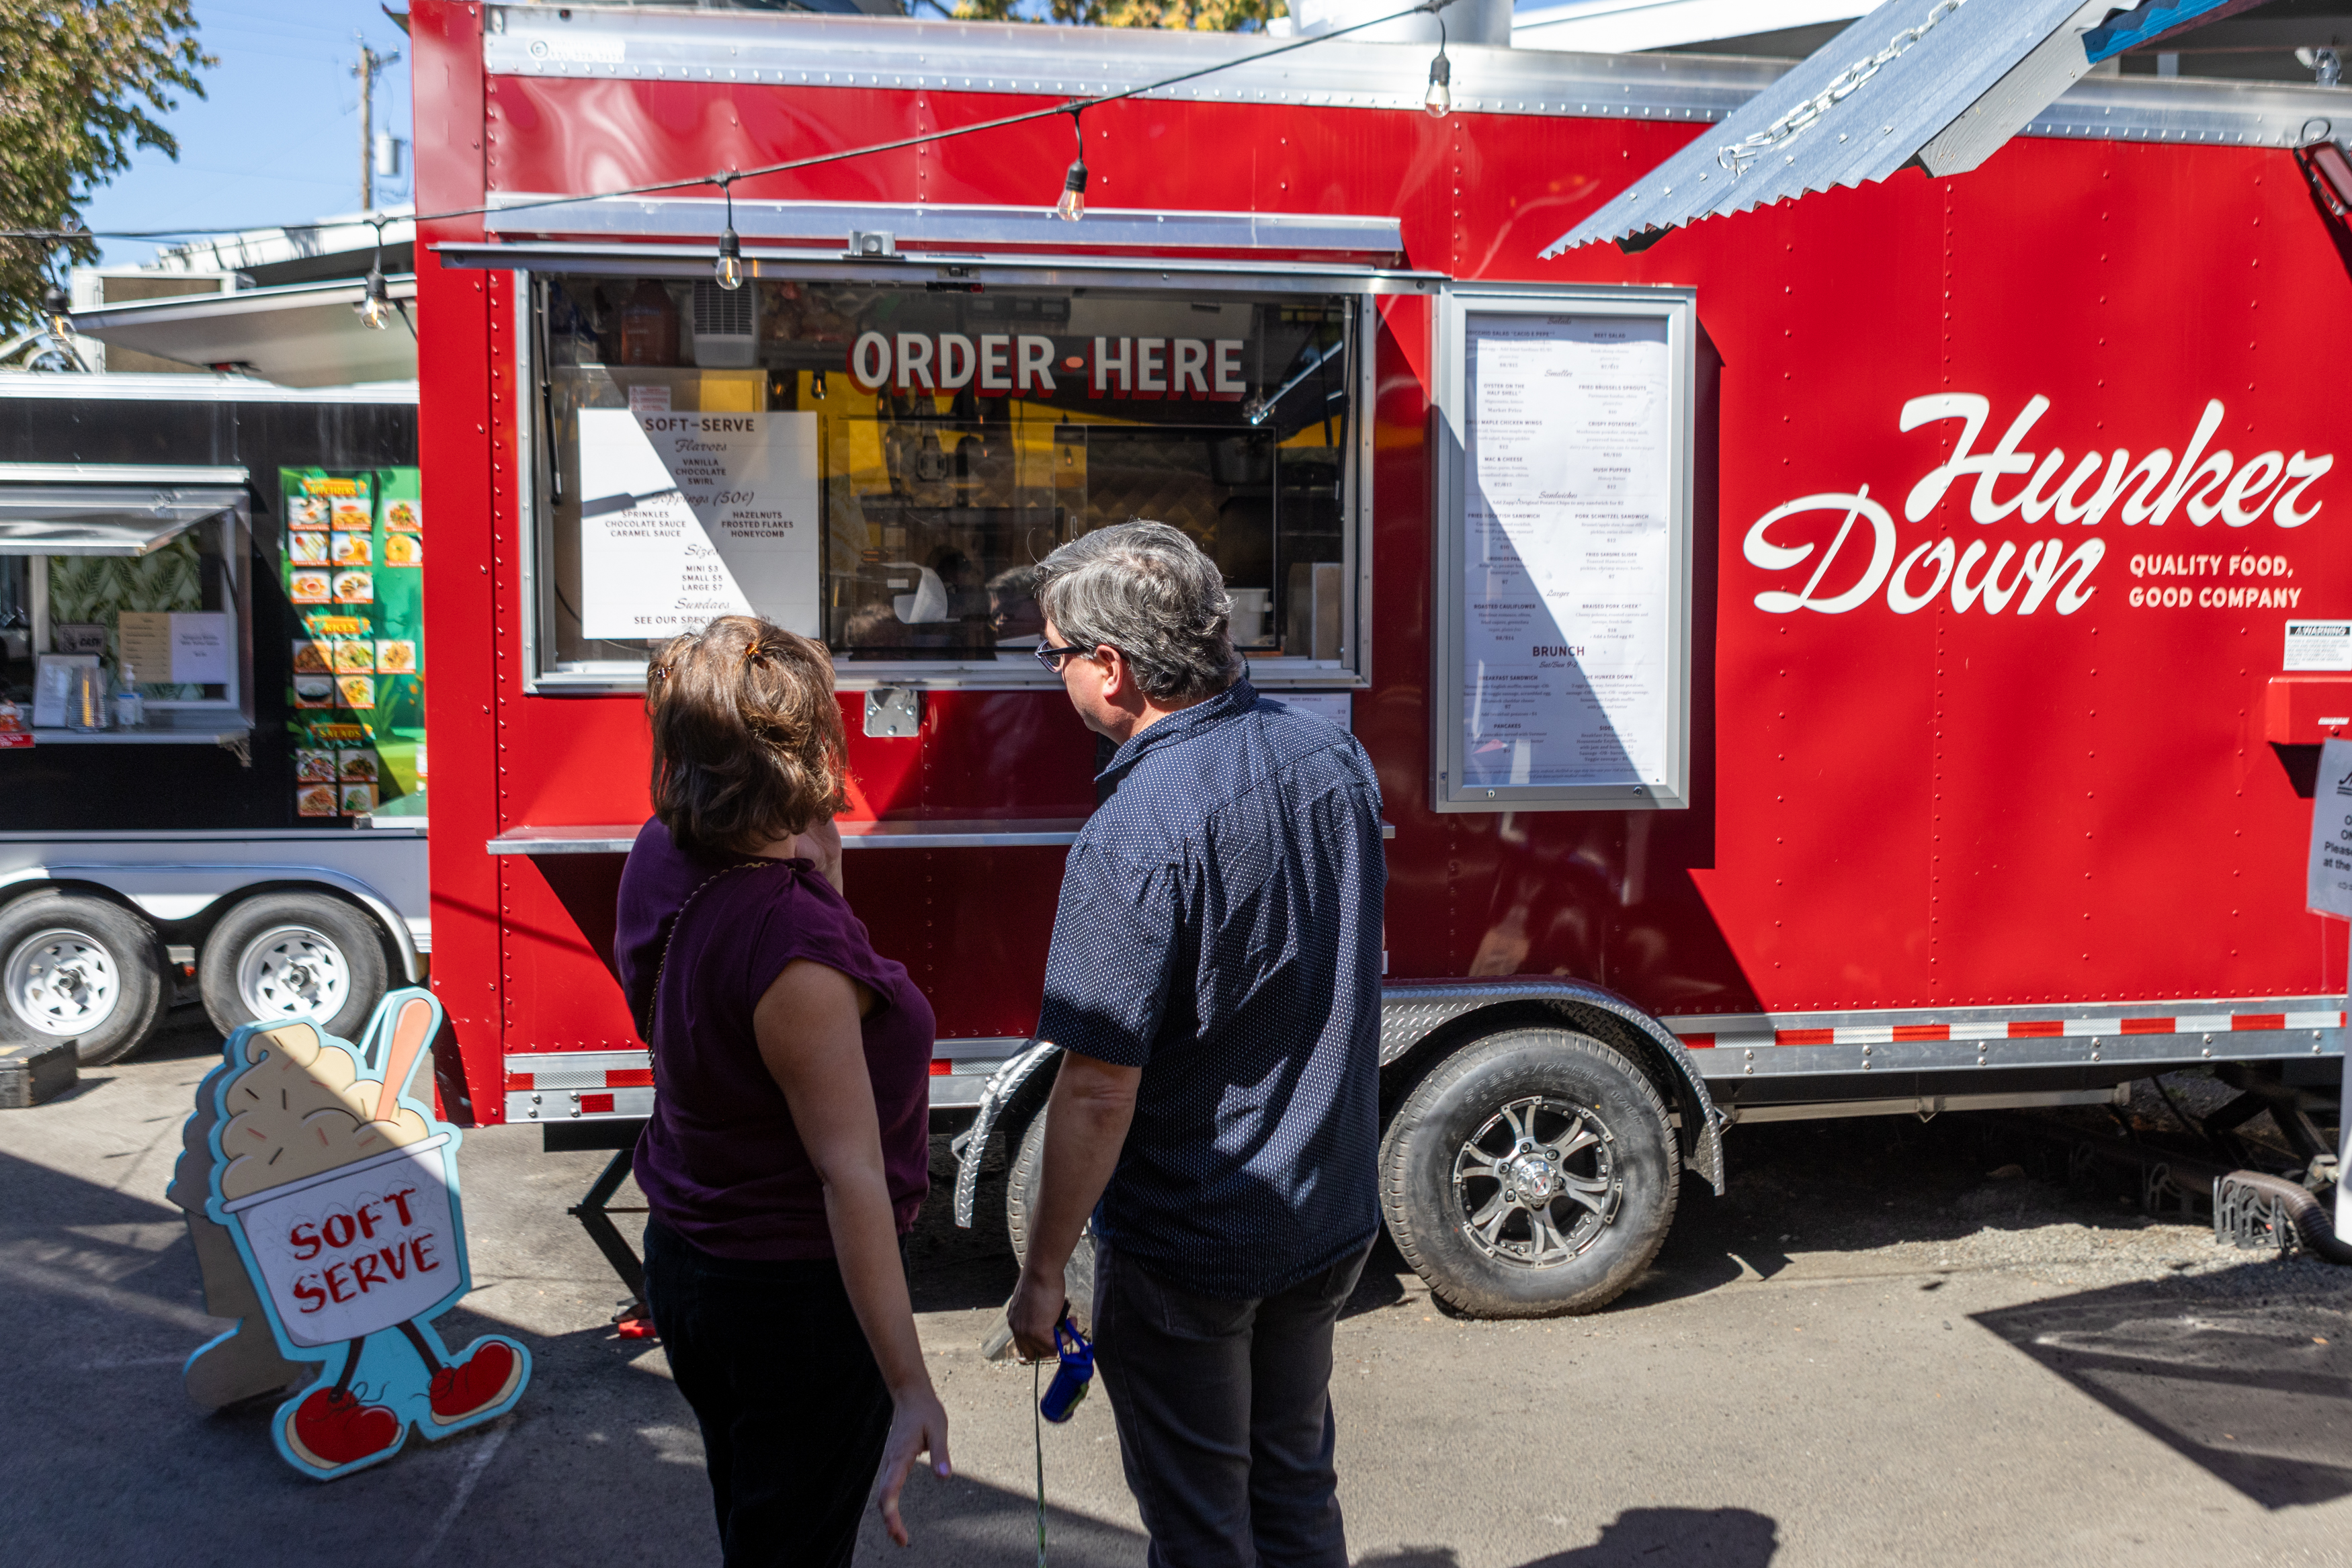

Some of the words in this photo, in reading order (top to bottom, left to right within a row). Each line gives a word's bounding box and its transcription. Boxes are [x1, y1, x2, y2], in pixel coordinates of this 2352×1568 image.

[847, 331, 1057, 398] ORDER
[1087, 335, 1247, 402] HERE
[645, 418, 755, 433] SOFT-SERVE
[675, 439, 728, 453] Flavors
[683, 459, 719, 467] VANILLA
[1899, 392, 2335, 528] Hunker
[675, 468, 726, 476] CHOCOLATE
[687, 478, 715, 486] SWIRL
[310, 486, 356, 495] APPETIZERS
[1538, 491, 1578, 499] Sandwiches
[651, 491, 709, 507] Toppings
[721, 521, 761, 529] FROSTED
[762, 521, 794, 529] FLAKES
[610, 529, 652, 537] CARAMEL
[654, 529, 681, 537] SAUCE
[730, 530, 785, 538] HONEYCOMB
[684, 544, 720, 559] Sizes
[1742, 483, 2107, 615] Down
[2128, 555, 2223, 578] QUALITY
[2228, 555, 2294, 578] FOOD,
[682, 574, 710, 582] SMALL
[712, 574, 723, 582] $5
[682, 584, 710, 592] LARGE
[712, 584, 723, 592] $7
[1546, 589, 1570, 599] Larger
[2129, 586, 2192, 609] GOOD
[2199, 586, 2302, 609] COMPANY
[674, 598, 730, 610] Sundaes
[634, 617, 653, 625] SEE
[656, 617, 677, 625] OUR
[325, 624, 356, 632] RICES
[2302, 627, 2347, 636] WARNING
[1532, 646, 1585, 657] BRUNCH
[320, 730, 362, 738] SALADS
[2323, 857, 2333, 868] at
[2335, 859, 2351, 871] the
[290, 1188, 417, 1261] SOFT
[293, 1233, 440, 1313] SERVE
